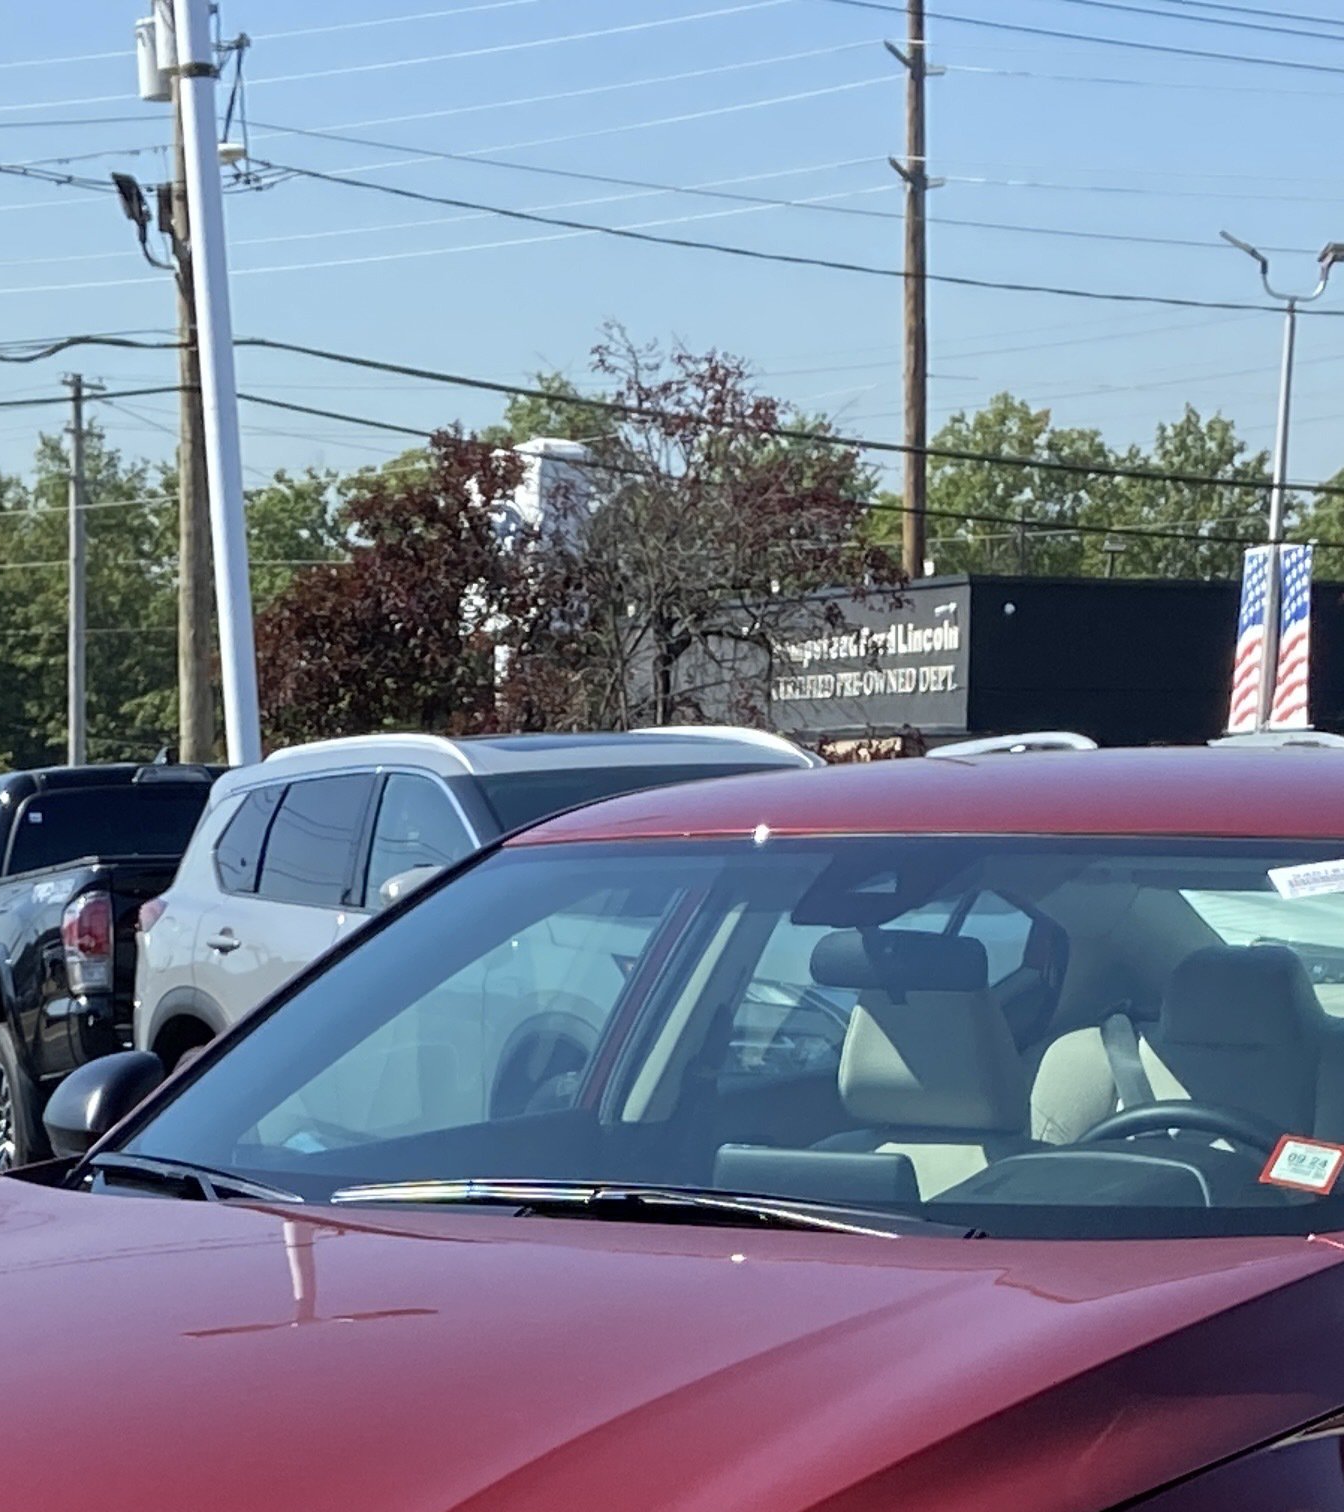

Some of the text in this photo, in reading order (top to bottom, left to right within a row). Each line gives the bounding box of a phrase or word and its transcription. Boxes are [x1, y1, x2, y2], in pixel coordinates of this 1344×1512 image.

[898, 620, 959, 653] Lincoln
[836, 667, 917, 697] PRE-OWNED
[918, 664, 958, 692] DEPT.
